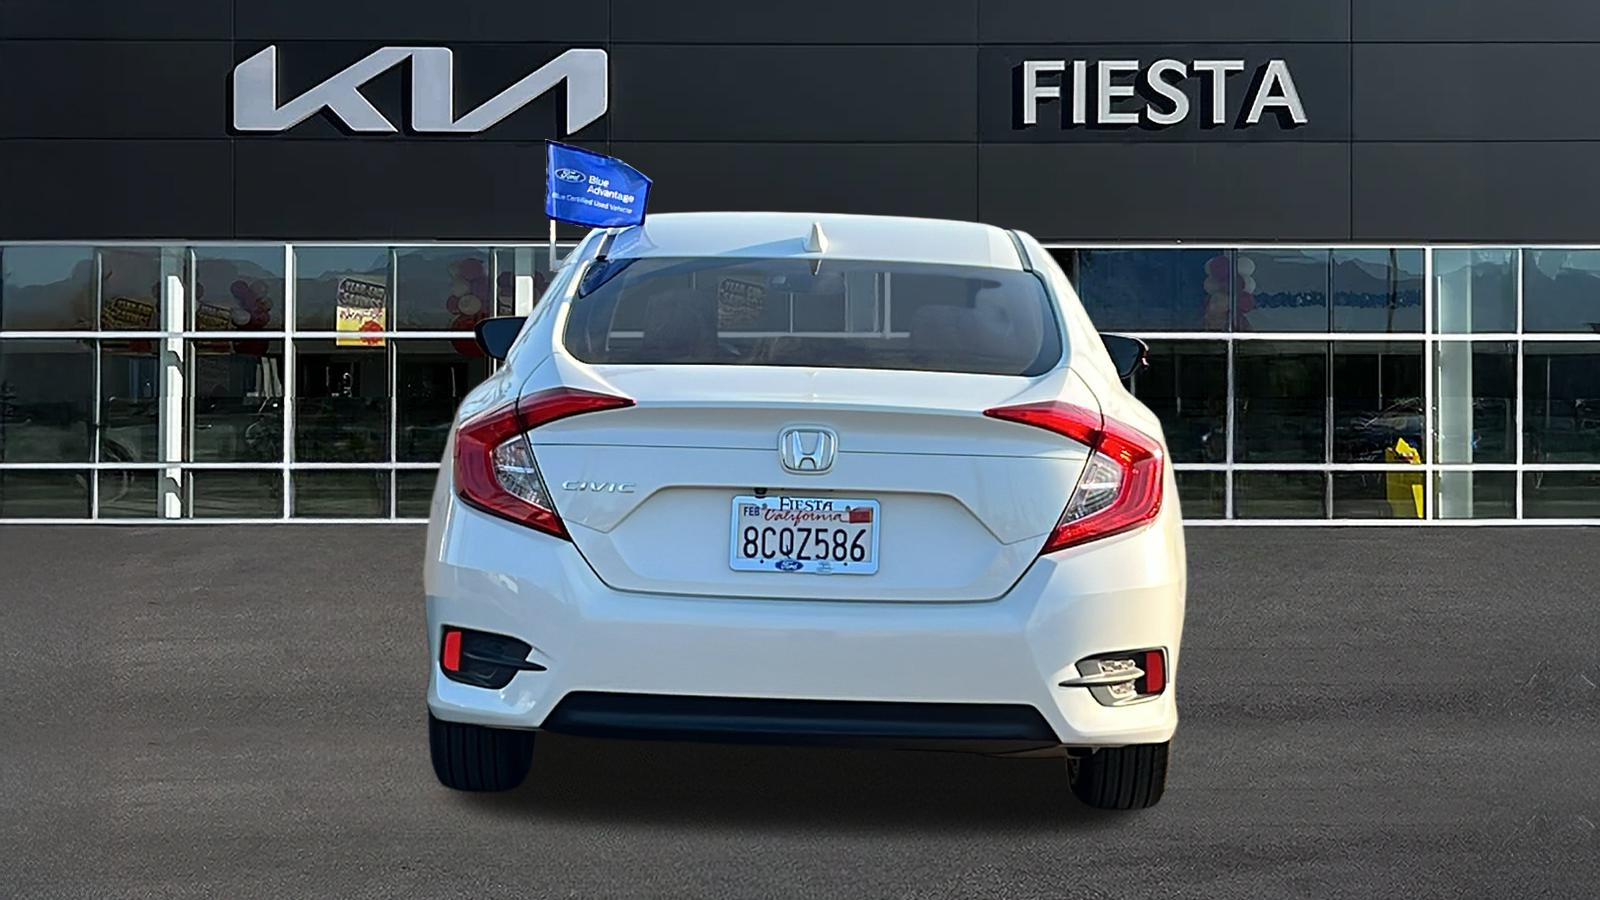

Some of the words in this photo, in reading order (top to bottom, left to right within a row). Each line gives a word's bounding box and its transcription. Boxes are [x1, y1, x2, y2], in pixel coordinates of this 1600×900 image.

[1023, 58, 1308, 125] FIESTA
[588, 175, 610, 188] Blue
[586, 185, 635, 204] Advantage
[594, 200, 609, 210] Used
[609, 204, 633, 214] Vehicle
[562, 480, 637, 494] CIVIC
[779, 496, 834, 512] FIESTA
[743, 505, 760, 517] FEB
[764, 508, 842, 527] California
[743, 525, 867, 562] 8CQZ586
